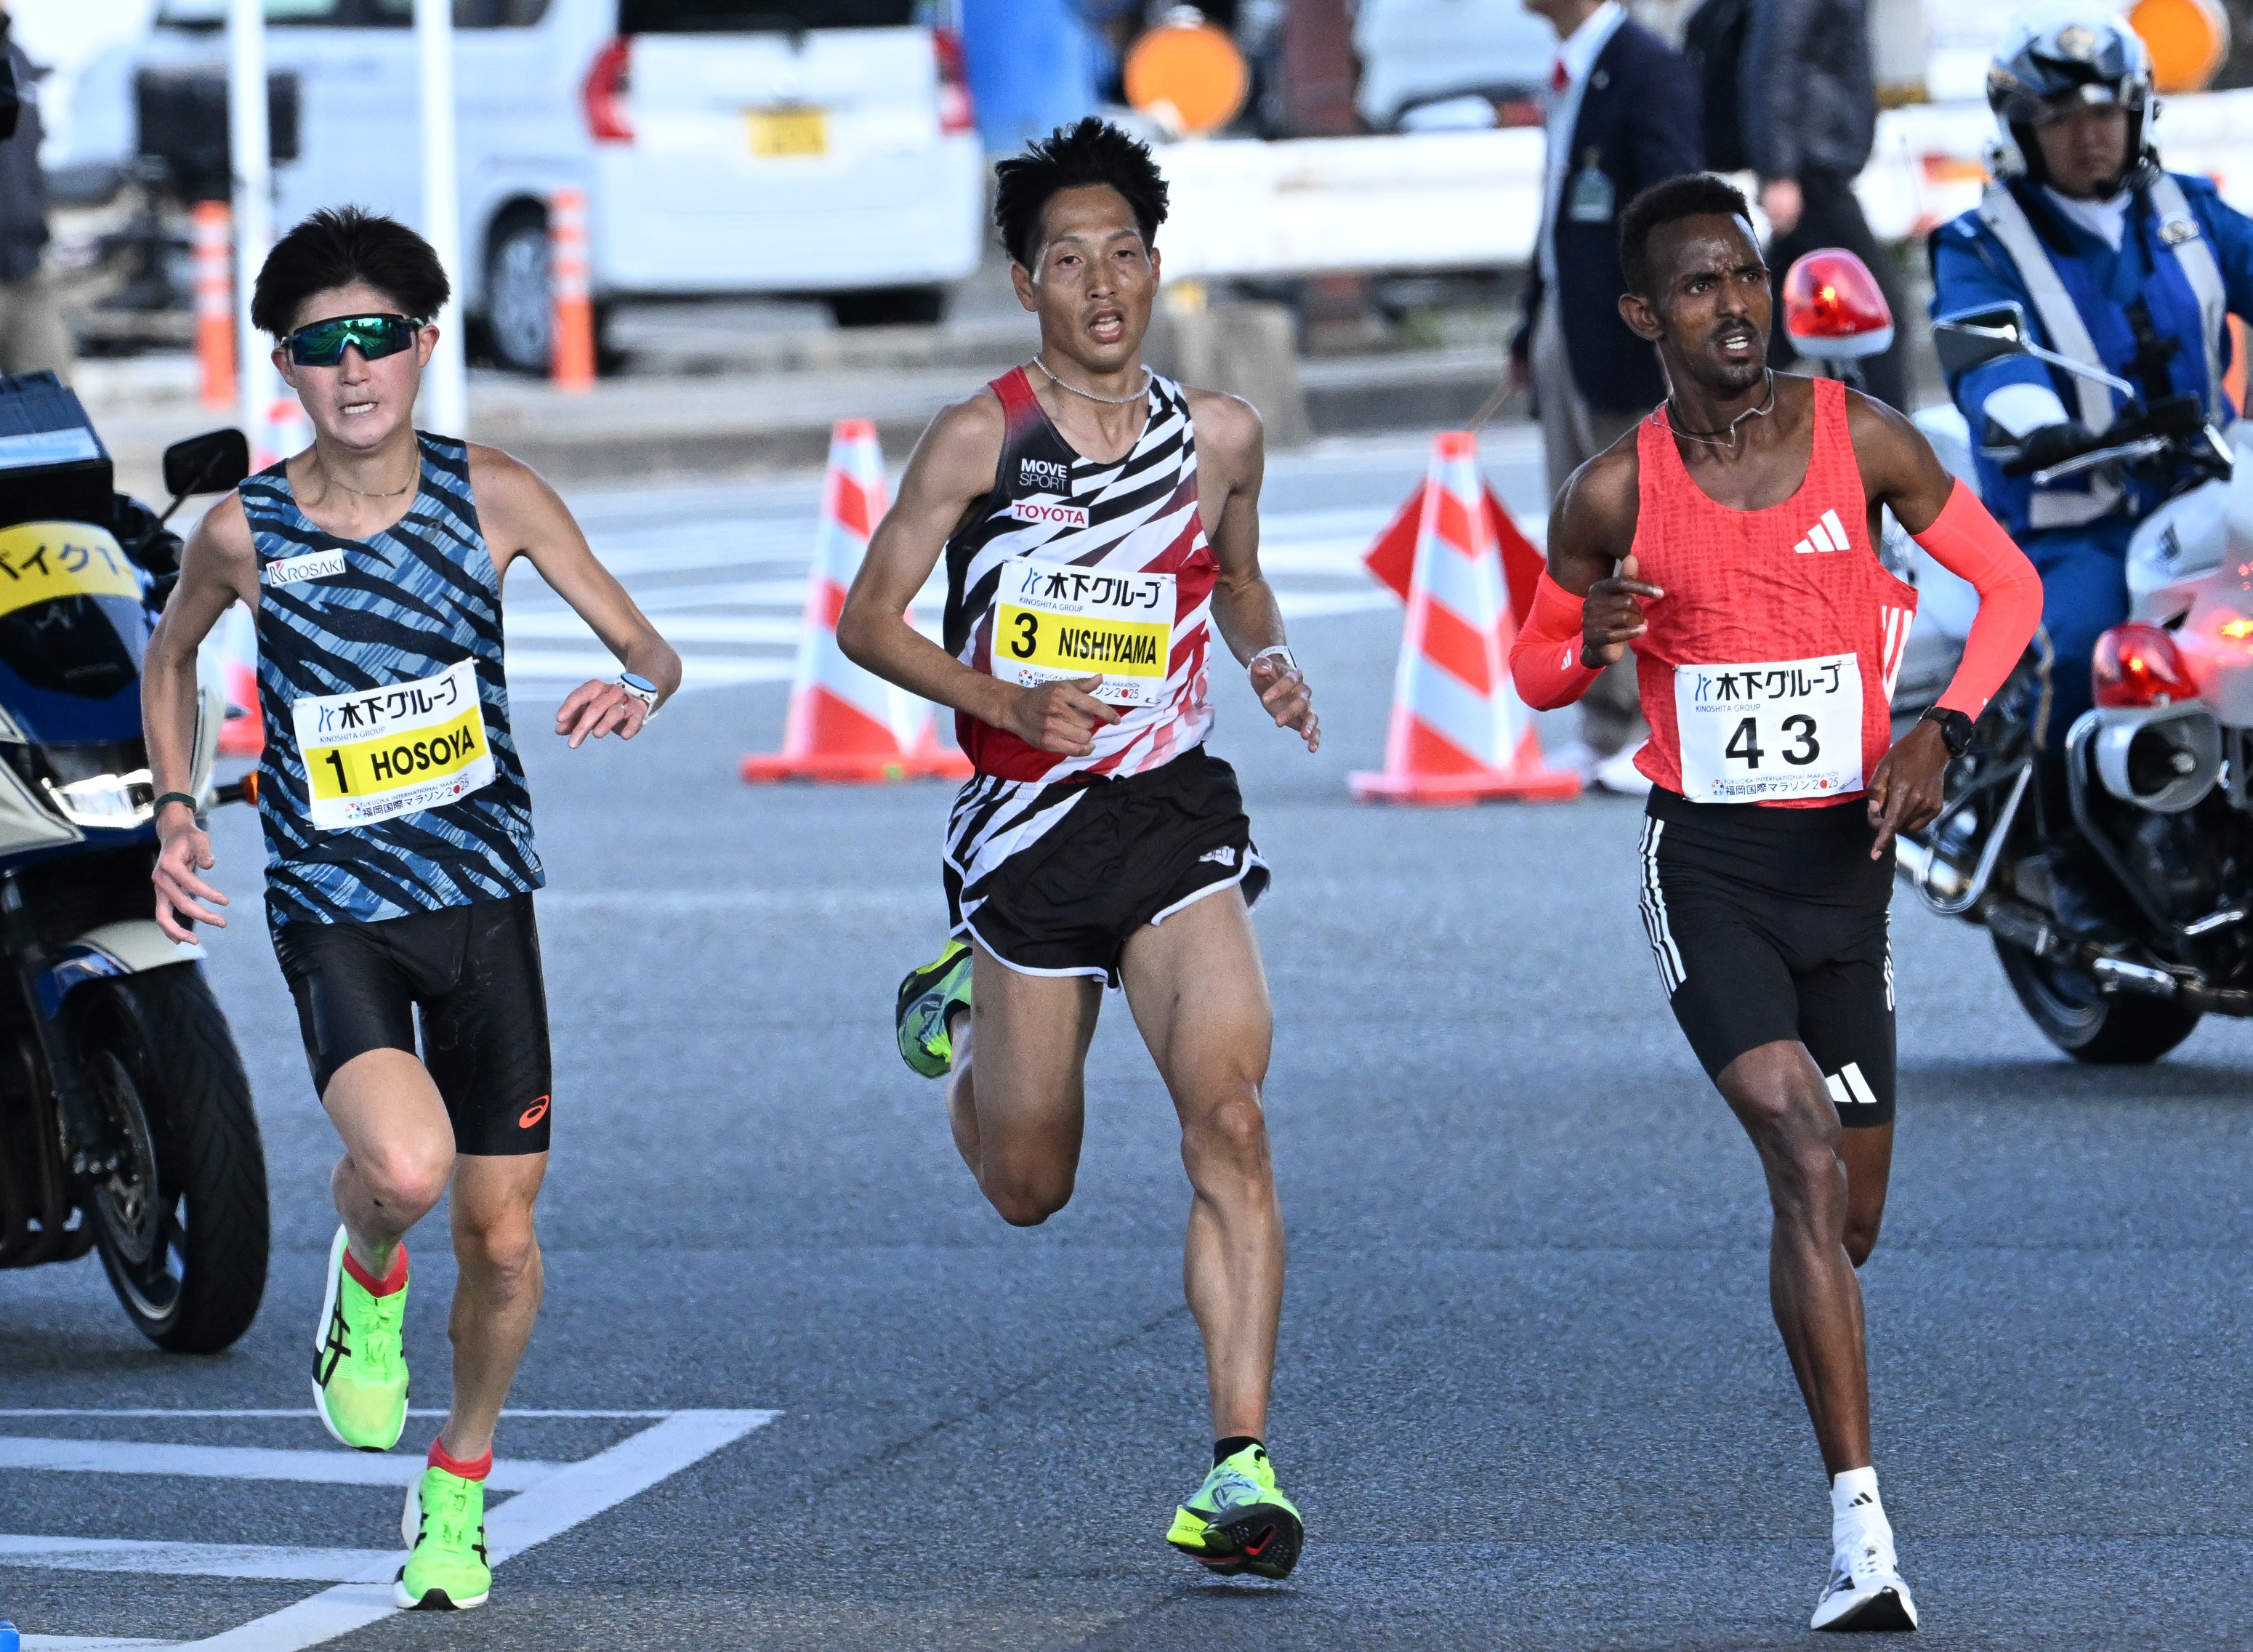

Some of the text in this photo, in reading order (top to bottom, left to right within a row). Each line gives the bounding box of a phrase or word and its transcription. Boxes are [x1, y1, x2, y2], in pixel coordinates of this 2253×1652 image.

[1021, 458, 1067, 478] MOVE
[1019, 472, 1067, 491] SPORT
[1015, 504, 1085, 524] TOYOTA
[270, 558, 343, 584] KROSAKI
[1044, 572, 1161, 609] 木下グループ
[1019, 597, 1084, 613] KINOSHITA GROUP
[1011, 612, 1157, 665] 3 NISHIYAMA
[1034, 672, 1063, 680] FUKUOKA
[1716, 663, 1840, 701] 木下グループ
[338, 674, 458, 730] 木下グループ
[1696, 703, 1761, 713] KINOSHITA GROUP
[320, 726, 385, 744] KINOSHITA GROUP
[326, 725, 475, 794] 1 HOSOYA
[1756, 773, 1805, 782] INTERNATIONAL
[360, 772, 468, 807] FUKUOKA INTERNATIONAL MARATHON
